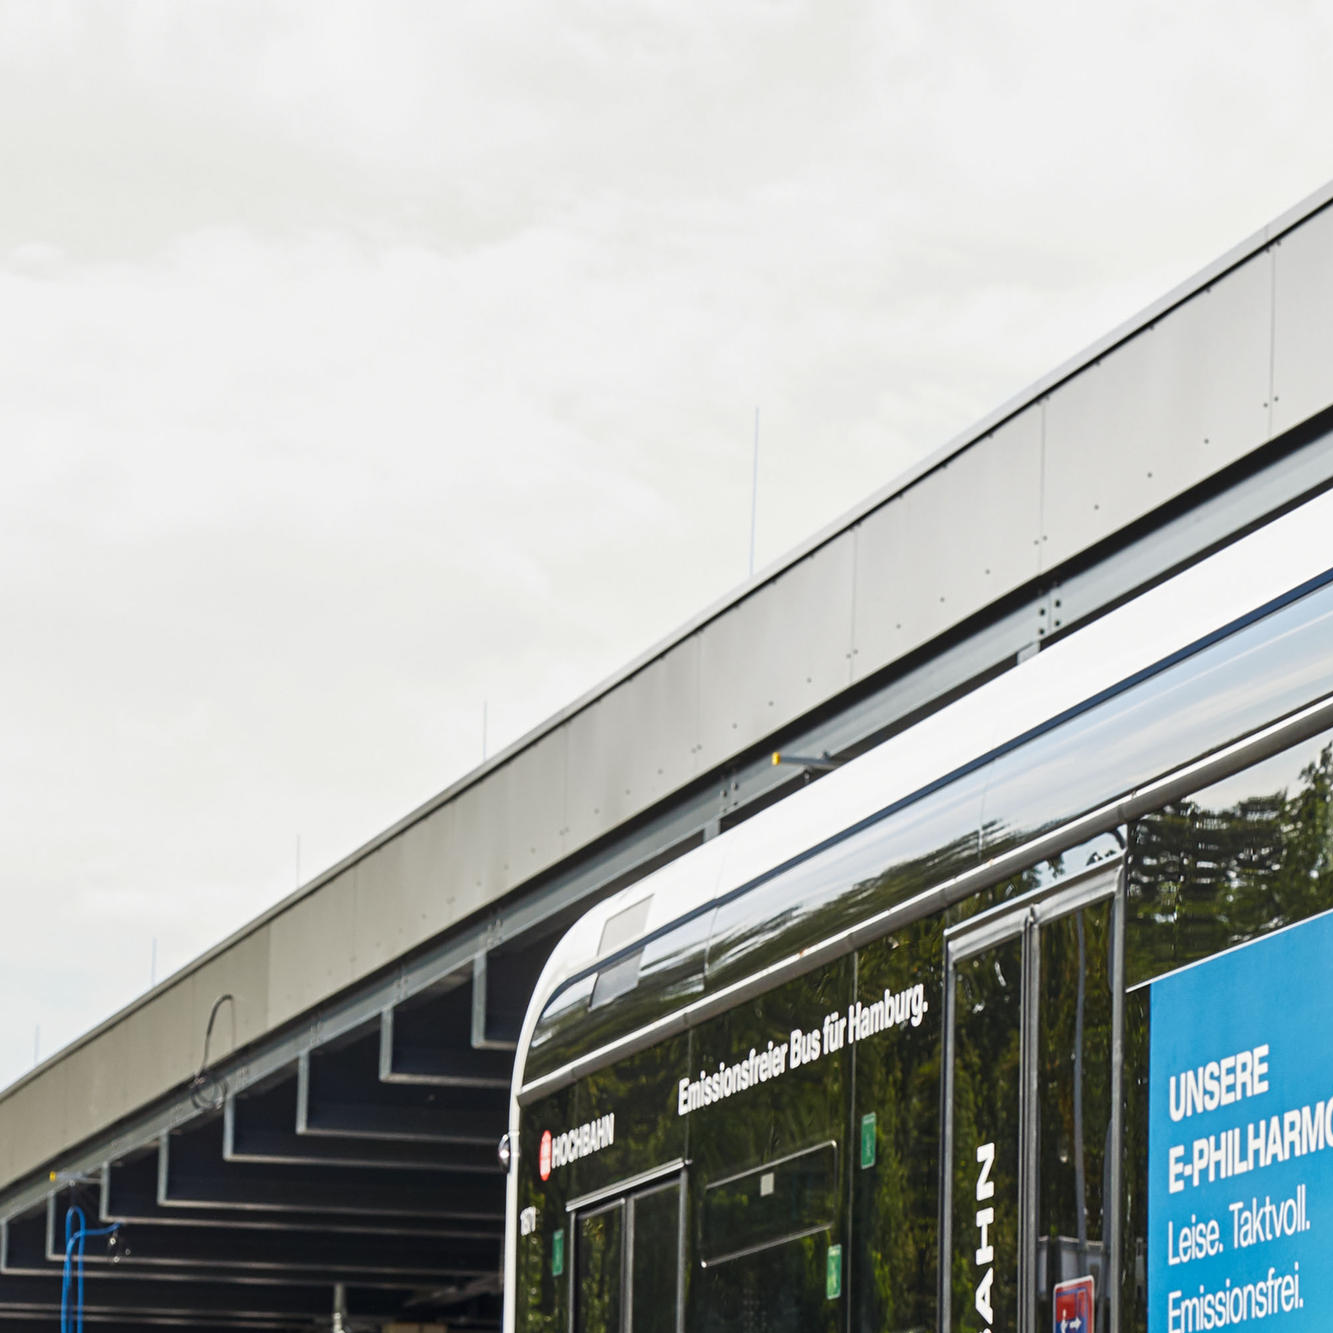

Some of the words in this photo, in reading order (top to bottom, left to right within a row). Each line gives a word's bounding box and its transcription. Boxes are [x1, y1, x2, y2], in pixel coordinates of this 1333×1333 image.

[678, 1040, 788, 1117] Emissionsfreier
[789, 1028, 821, 1070] Bus
[821, 1010, 847, 1056] für
[847, 982, 929, 1045] Hamburg.
[1168, 1043, 1271, 1122] UNSERE
[551, 1111, 615, 1170] HOCHBAHN
[1167, 1213, 1224, 1267] Leise.
[1229, 1184, 1311, 1248] Taktvoll.
